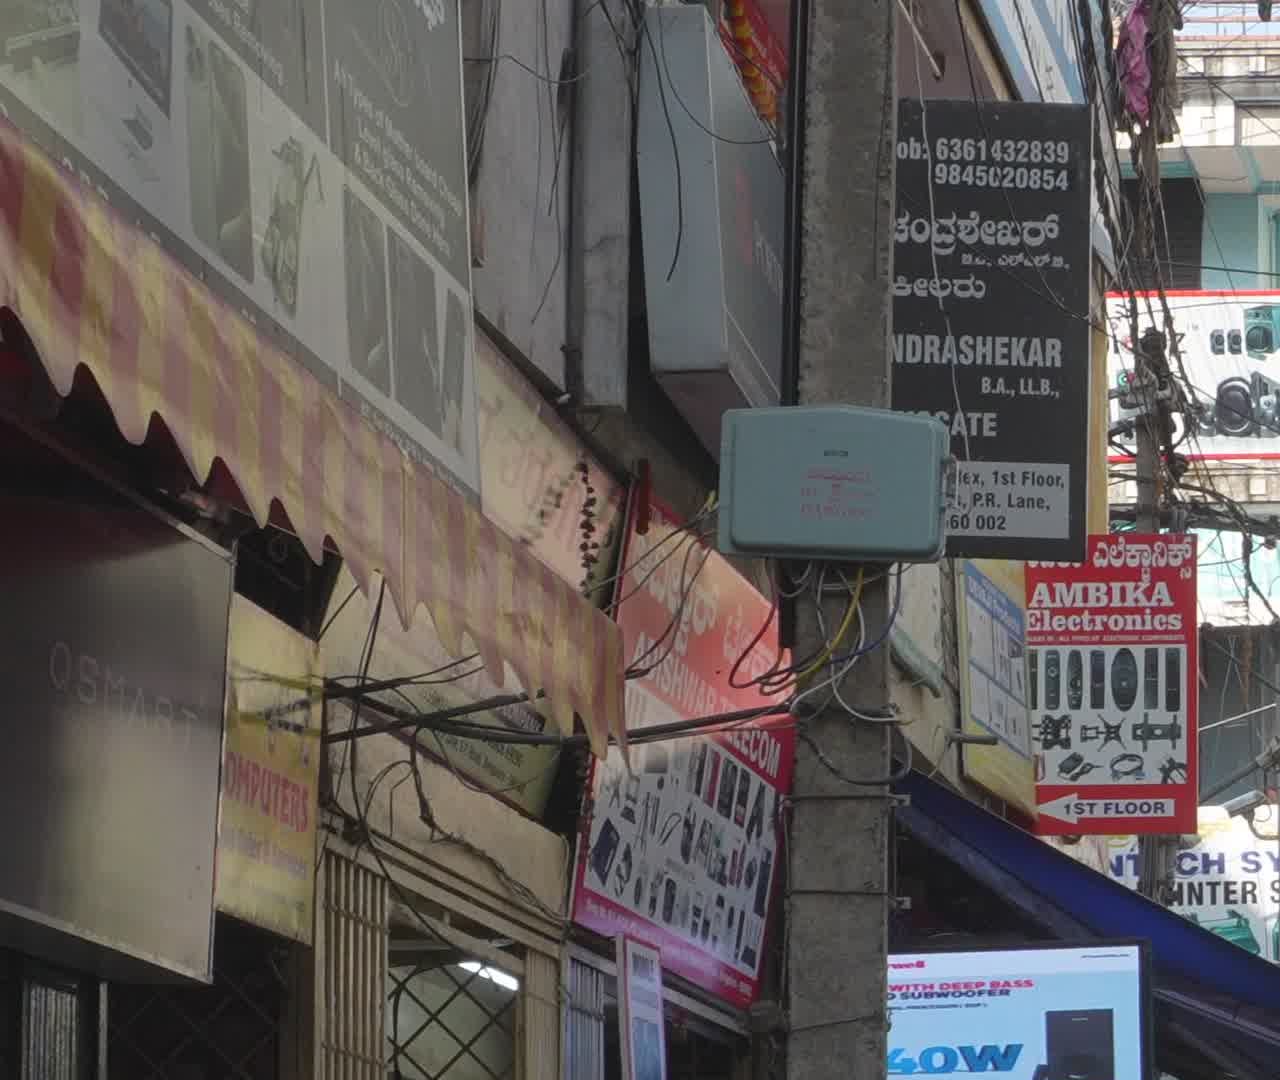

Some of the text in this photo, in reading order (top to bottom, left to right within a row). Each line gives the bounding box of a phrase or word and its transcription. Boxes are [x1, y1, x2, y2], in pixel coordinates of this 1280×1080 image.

[935, 137, 1069, 163] 6361432839
[934, 163, 1069, 191] 9845020854
[991, 469, 1066, 489] 1st Floor,
[973, 493, 1001, 508] P.R.
[1007, 493, 1050, 512] Lane,
[975, 514, 1007, 531] 002
[1029, 580, 1174, 609] AMBIKA
[1026, 608, 1183, 632] Electronics
[1063, 802, 1166, 816] 1ST FLOOR
[900, 988, 1011, 1000] SUBWOOFER
[939, 980, 987, 991] DEEP
[989, 978, 1035, 990] BASS
